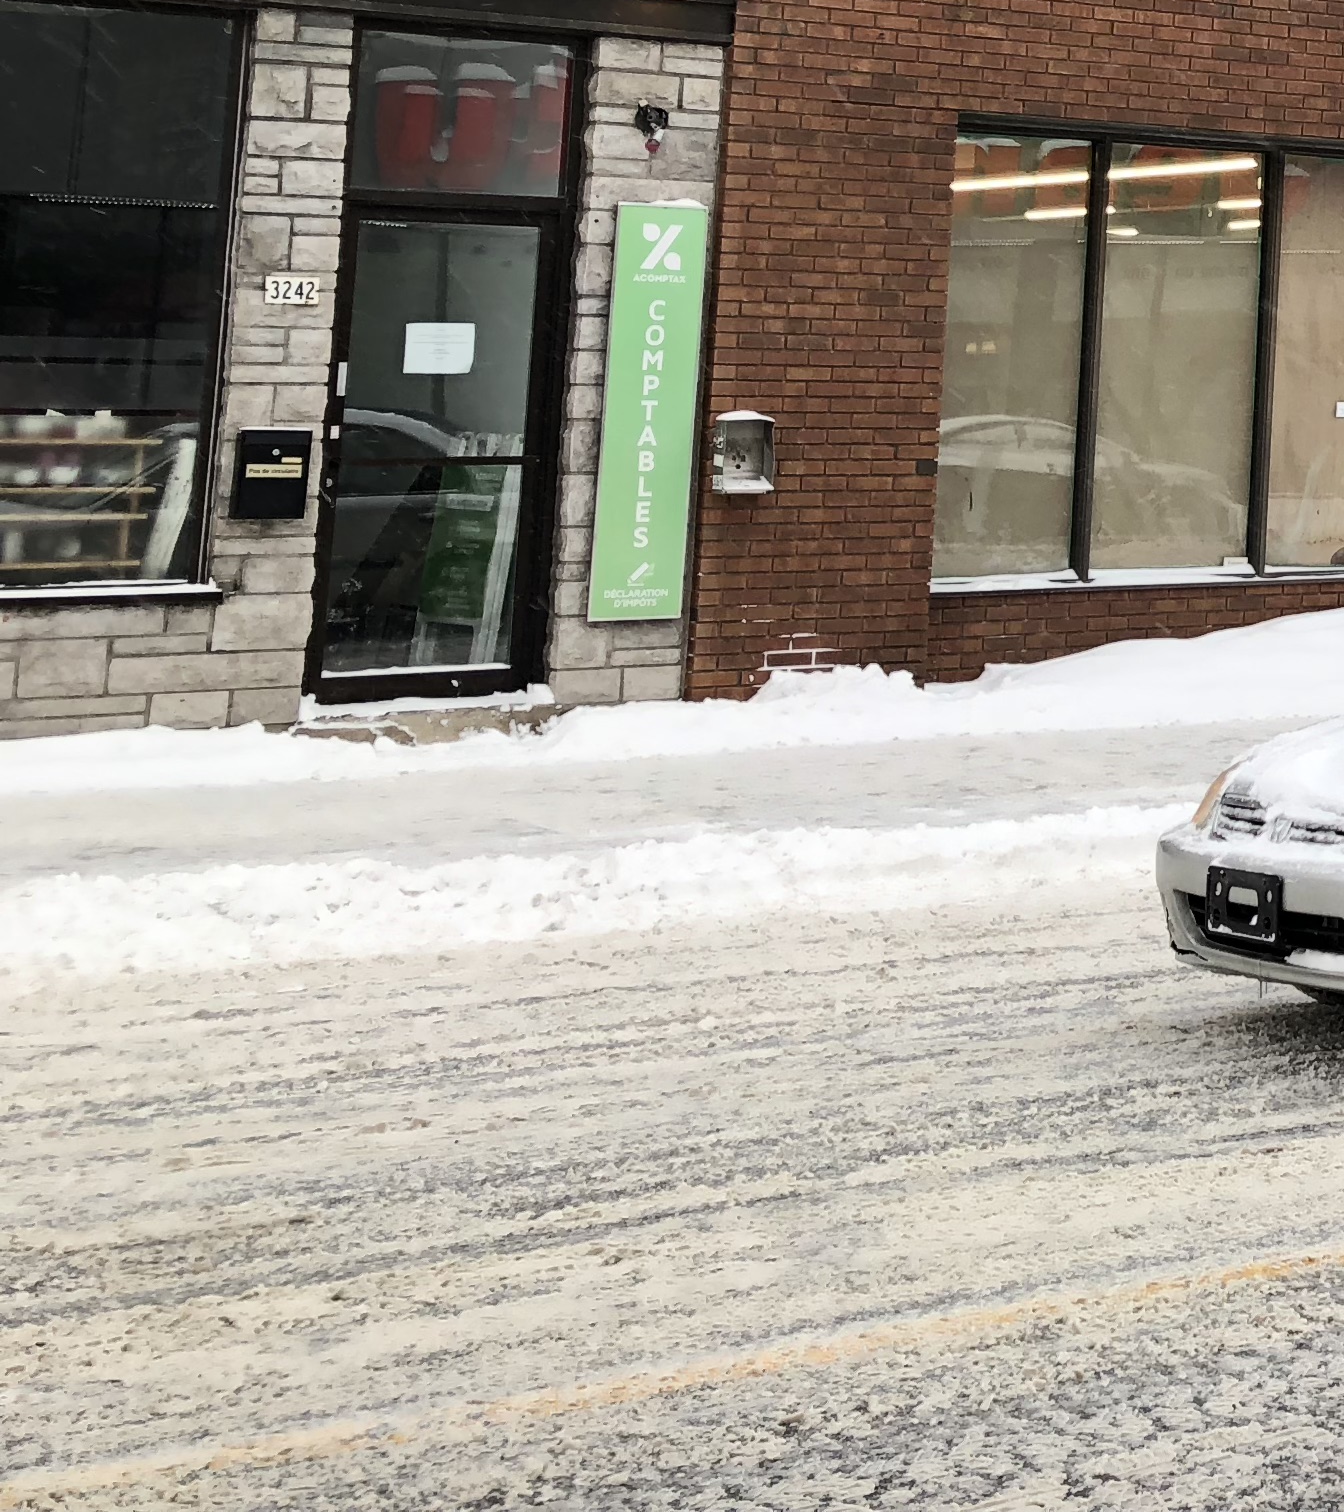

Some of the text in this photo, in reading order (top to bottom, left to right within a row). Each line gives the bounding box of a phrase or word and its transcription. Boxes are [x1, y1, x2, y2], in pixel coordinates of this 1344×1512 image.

[633, 273, 686, 284] ACOMPTAX
[271, 280, 316, 301] 3242
[633, 299, 667, 549] COMPTABLES
[604, 588, 669, 599] DÉCLARATION
